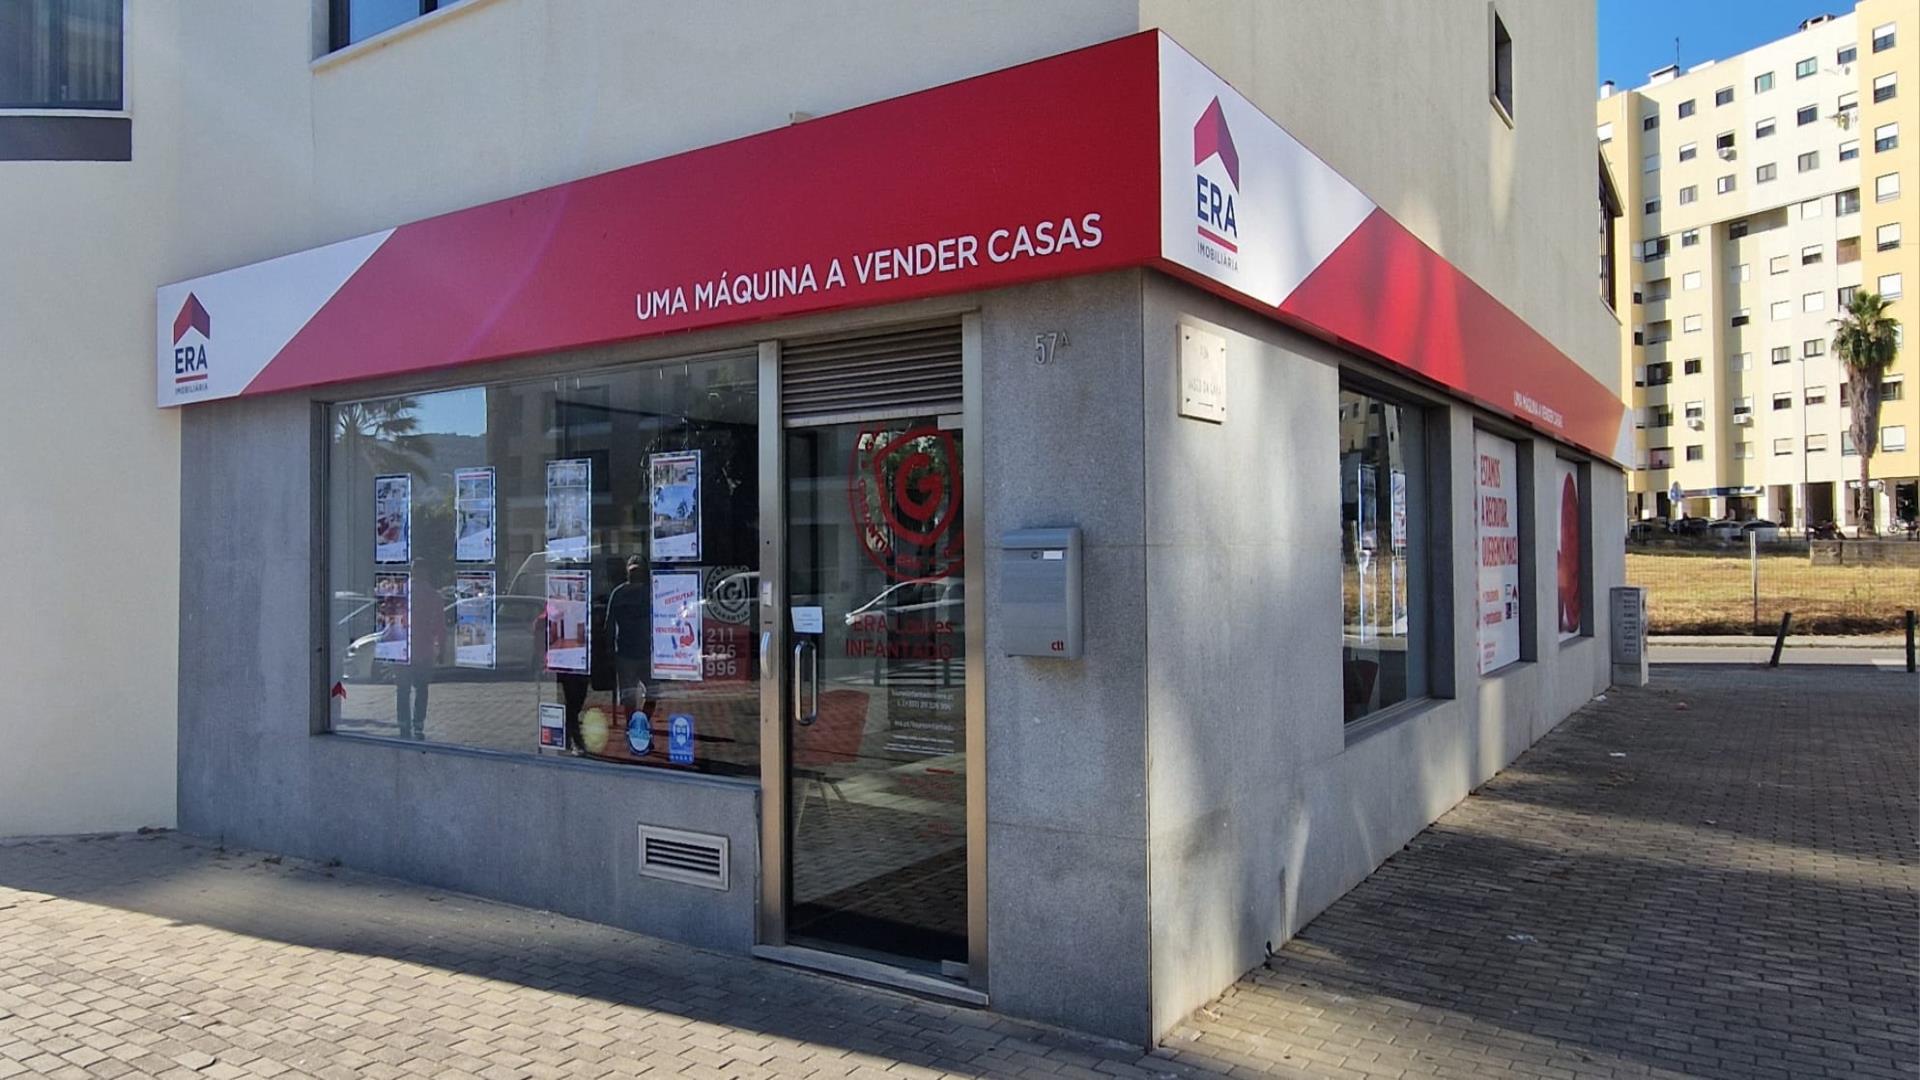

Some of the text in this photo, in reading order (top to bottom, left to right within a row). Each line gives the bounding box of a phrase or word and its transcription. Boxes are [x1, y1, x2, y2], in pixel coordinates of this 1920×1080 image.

[1197, 174, 1238, 239] ERA
[636, 212, 1103, 321] UMA MÁQUINA A VENDER CASAS
[175, 344, 208, 374] ERA
[707, 627, 734, 643] 211
[854, 615, 887, 633] ERA
[706, 661, 737, 677] 996
